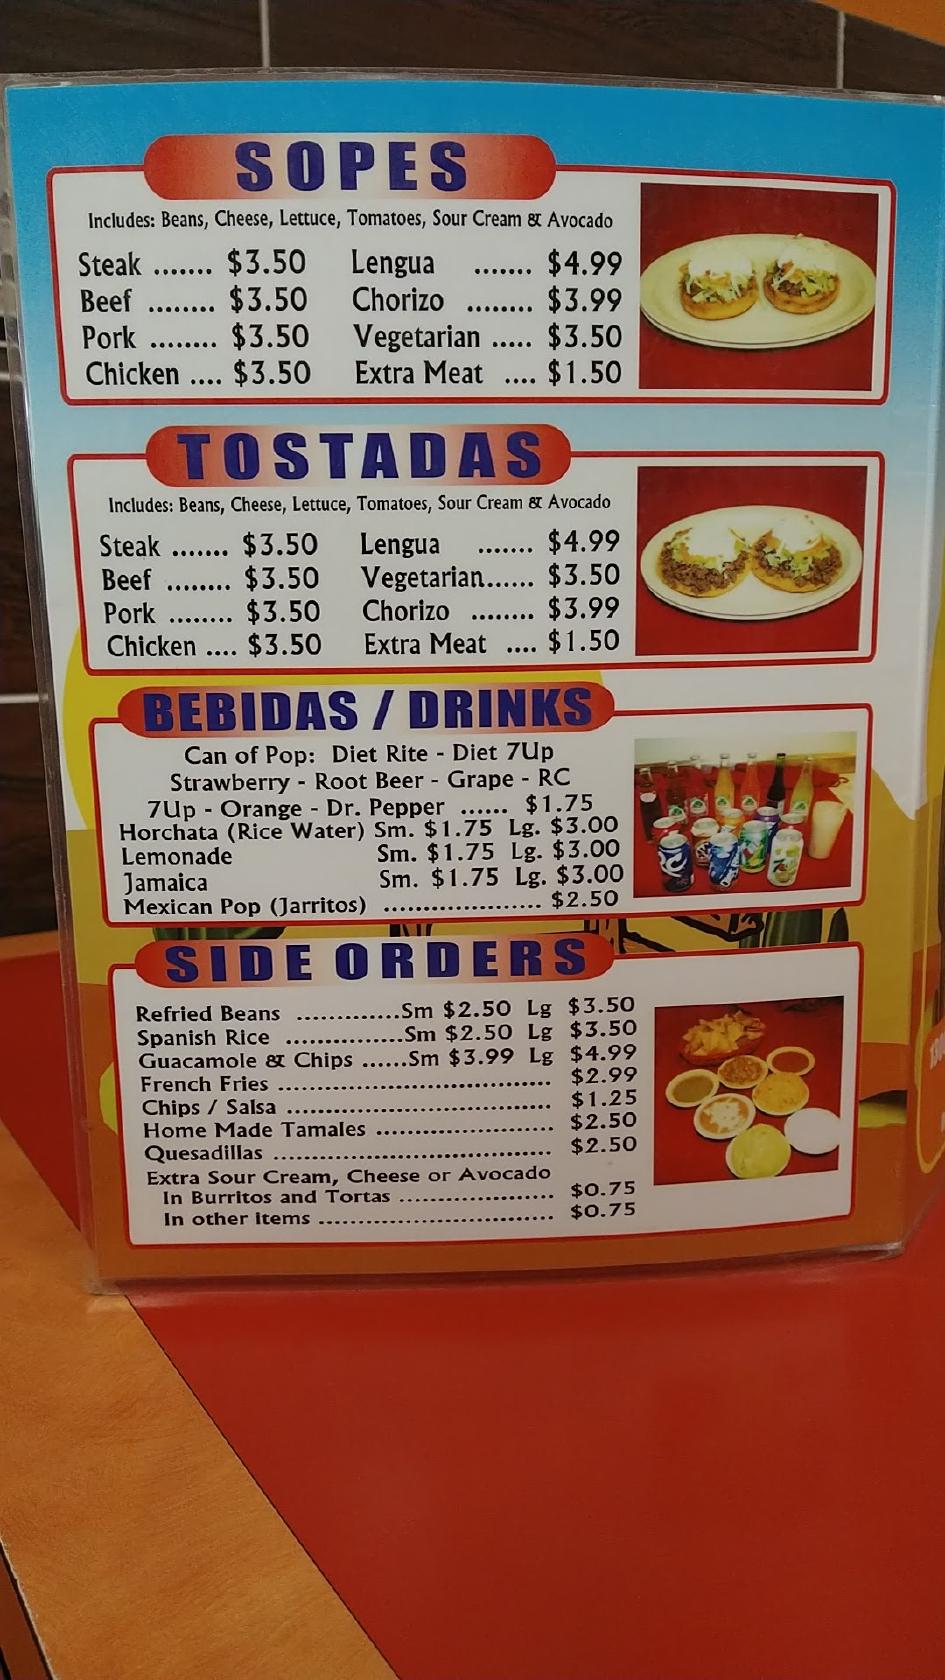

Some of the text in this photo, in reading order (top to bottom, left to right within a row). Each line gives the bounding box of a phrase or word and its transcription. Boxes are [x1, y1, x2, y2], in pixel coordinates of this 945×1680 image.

[235, 141, 466, 191] SOPES
[89, 209, 612, 229] Includes: Beans, Cheese, Lettuce, Tomatoes, Sour Cream & Avocado
[79, 248, 305, 276] Steak $3.50
[352, 249, 622, 278] Lengua $4.99
[81, 285, 307, 313] Beef $3.50
[353, 285, 621, 314] Chorizo $3.99
[83, 322, 309, 350] Pork $3.50
[354, 322, 621, 352] Vegetarian $3.50
[86, 359, 310, 387] Chicken $3.50
[356, 359, 621, 386] Extra Meat $1.50
[177, 431, 540, 480] TOSTADAS
[109, 494, 610, 515] Includes: Beans, Cheese, Lettuce, Tomatoes, Sour Cream & Avocado
[100, 532, 317, 557] Steak $3.50
[361, 529, 619, 558] Lengua $4.99
[102, 565, 318, 592] Beef $3.50
[549, 563, 619, 588] $3.50
[104, 599, 319, 625] Pork $3.50
[363, 596, 619, 621] Chorizo $3.99
[108, 633, 321, 657] Chicken $3.50
[365, 629, 619, 654] Extra Meat $1.50
[144, 688, 591, 731] BEBIDAS / DRINKS
[185, 746, 226, 764] Can
[235, 746, 258, 764] of
[266, 746, 314, 767] Pop:
[333, 745, 377, 762] Diet
[387, 745, 427, 762] Rite
[453, 744, 497, 761] Diet
[507, 742, 553, 763] 7Up
[171, 774, 290, 794] Strawberry
[316, 773, 367, 789] Root
[376, 772, 423, 788] Beer
[448, 770, 513, 790] Grape
[539, 768, 570, 787] RC
[148, 801, 195, 821] 7Up
[221, 800, 301, 820] Orange
[327, 799, 360, 816] Dr.
[370, 798, 444, 818] Pepper
[526, 794, 592, 815] $1.75
[120, 816, 618, 843] Horchata (Rice Water) Sm. $1.75 Lg. $3.00
[122, 839, 619, 865] Lemonade Sm. $1.75 Lg. $3.00
[124, 864, 623, 895] Jamaica Sm. $1.75 Lg. $3.00
[124, 890, 618, 917] Mexican Pop (Jarritos) $2.50
[166, 938, 585, 983] SIDE ORDERS
[137, 997, 634, 1022] Refried Beans Sm $2.50 Lg $3.50
[138, 1020, 636, 1048] Spanish Rice Sm $2.50 Lg $3.50
[139, 1044, 636, 1070] Guacamole & Chips Sm $3.99 Lg $4.99
[141, 1067, 637, 1092] French Fries $2.99
[143, 1089, 636, 1117] Chips / Salsa $1.25
[144, 1112, 636, 1138] Home Made Tamales $2.50
[145, 1137, 636, 1164] Quesadillas $2.50
[147, 1166, 550, 1186] Extra Sour Cream, Cheese or Avocado
[164, 1181, 634, 1204] In Burritos and Tortas $0.75
[165, 1202, 635, 1226] In other items $0.75
